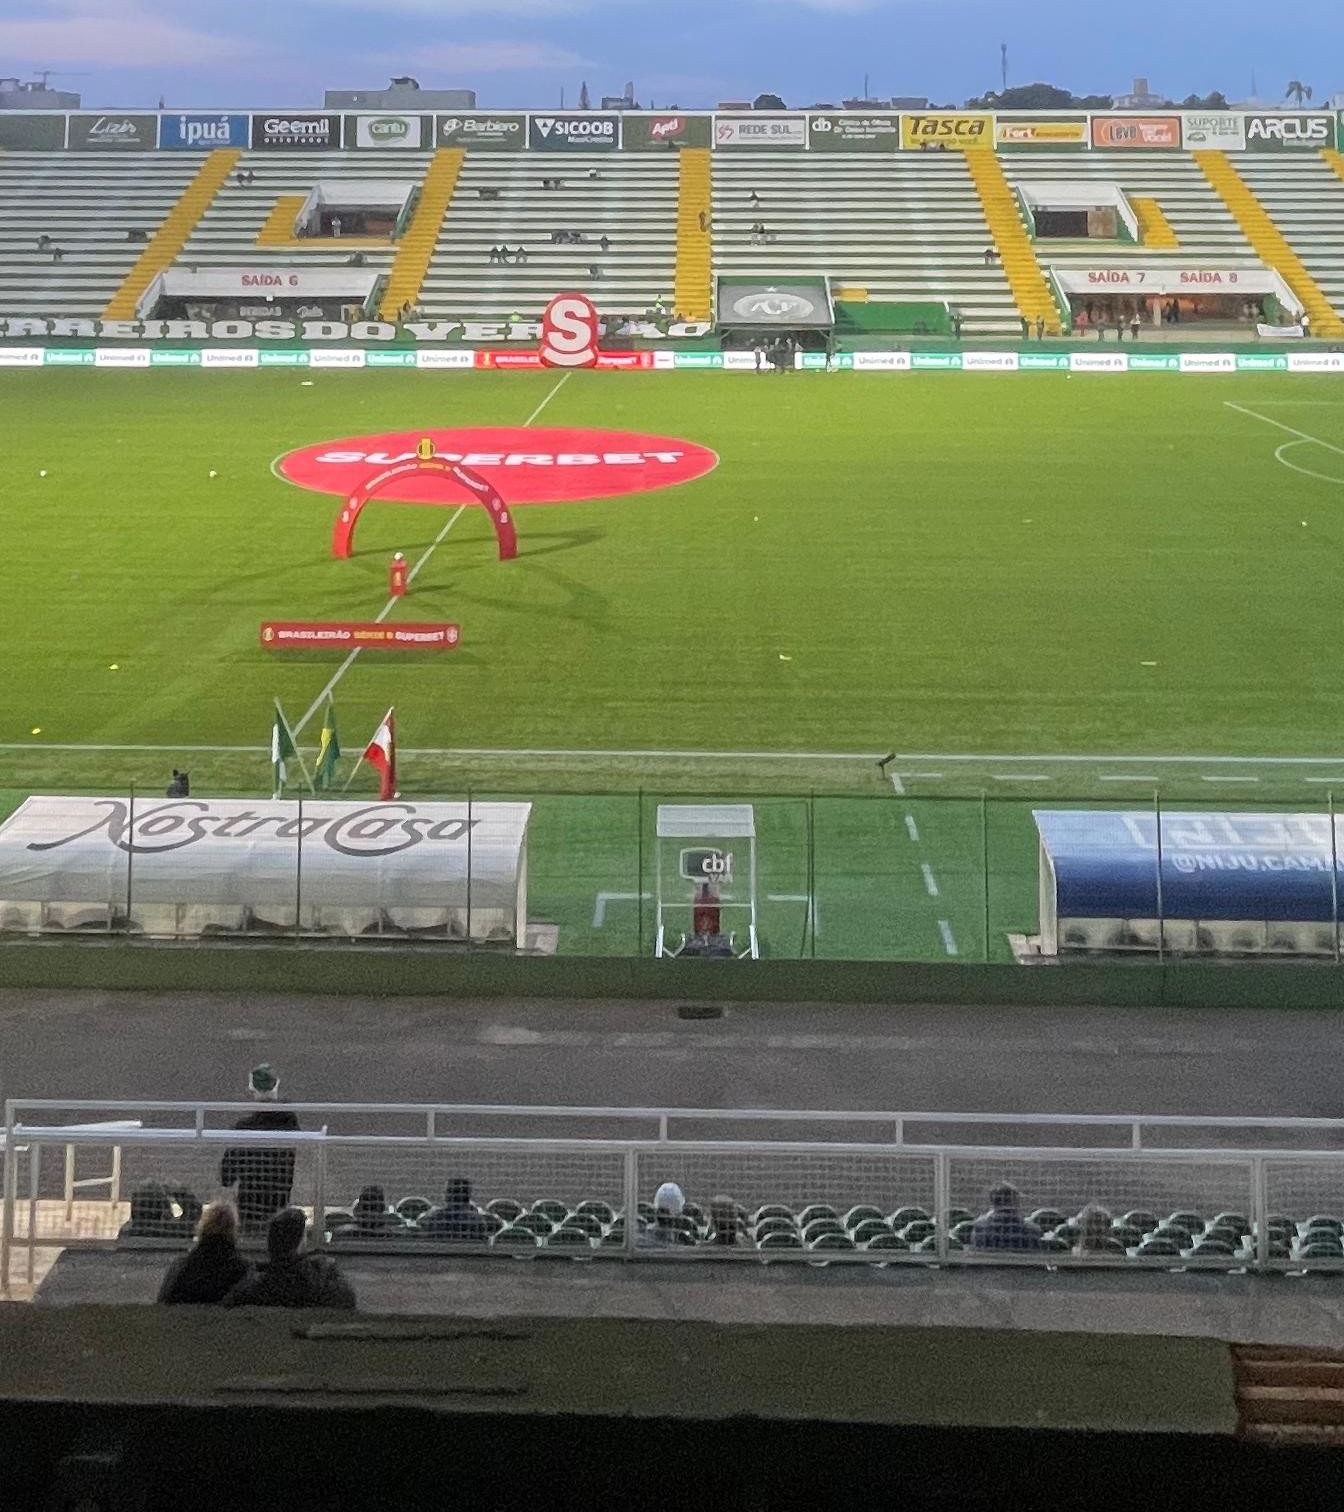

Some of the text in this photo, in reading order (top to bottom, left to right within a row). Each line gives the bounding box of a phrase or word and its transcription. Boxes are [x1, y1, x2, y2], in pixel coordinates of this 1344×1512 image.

[179, 115, 231, 145] ipuá
[264, 119, 330, 135] Geemil
[555, 120, 614, 136] SICOOB
[908, 116, 984, 136] Tasca
[1247, 118, 1329, 139] ARCUS
[240, 271, 282, 287] SAÍDA
[1087, 269, 1131, 285] SAÍDA
[1179, 269, 1222, 285] SAÍDA
[301, 321, 397, 341] DO
[548, 299, 592, 352] S
[858, 356, 895, 365] Unimed
[966, 356, 1003, 366] Unimed
[1075, 356, 1112, 367] Unimed
[1184, 357, 1220, 368] Unimed
[1292, 357, 1329, 368] Unimed
